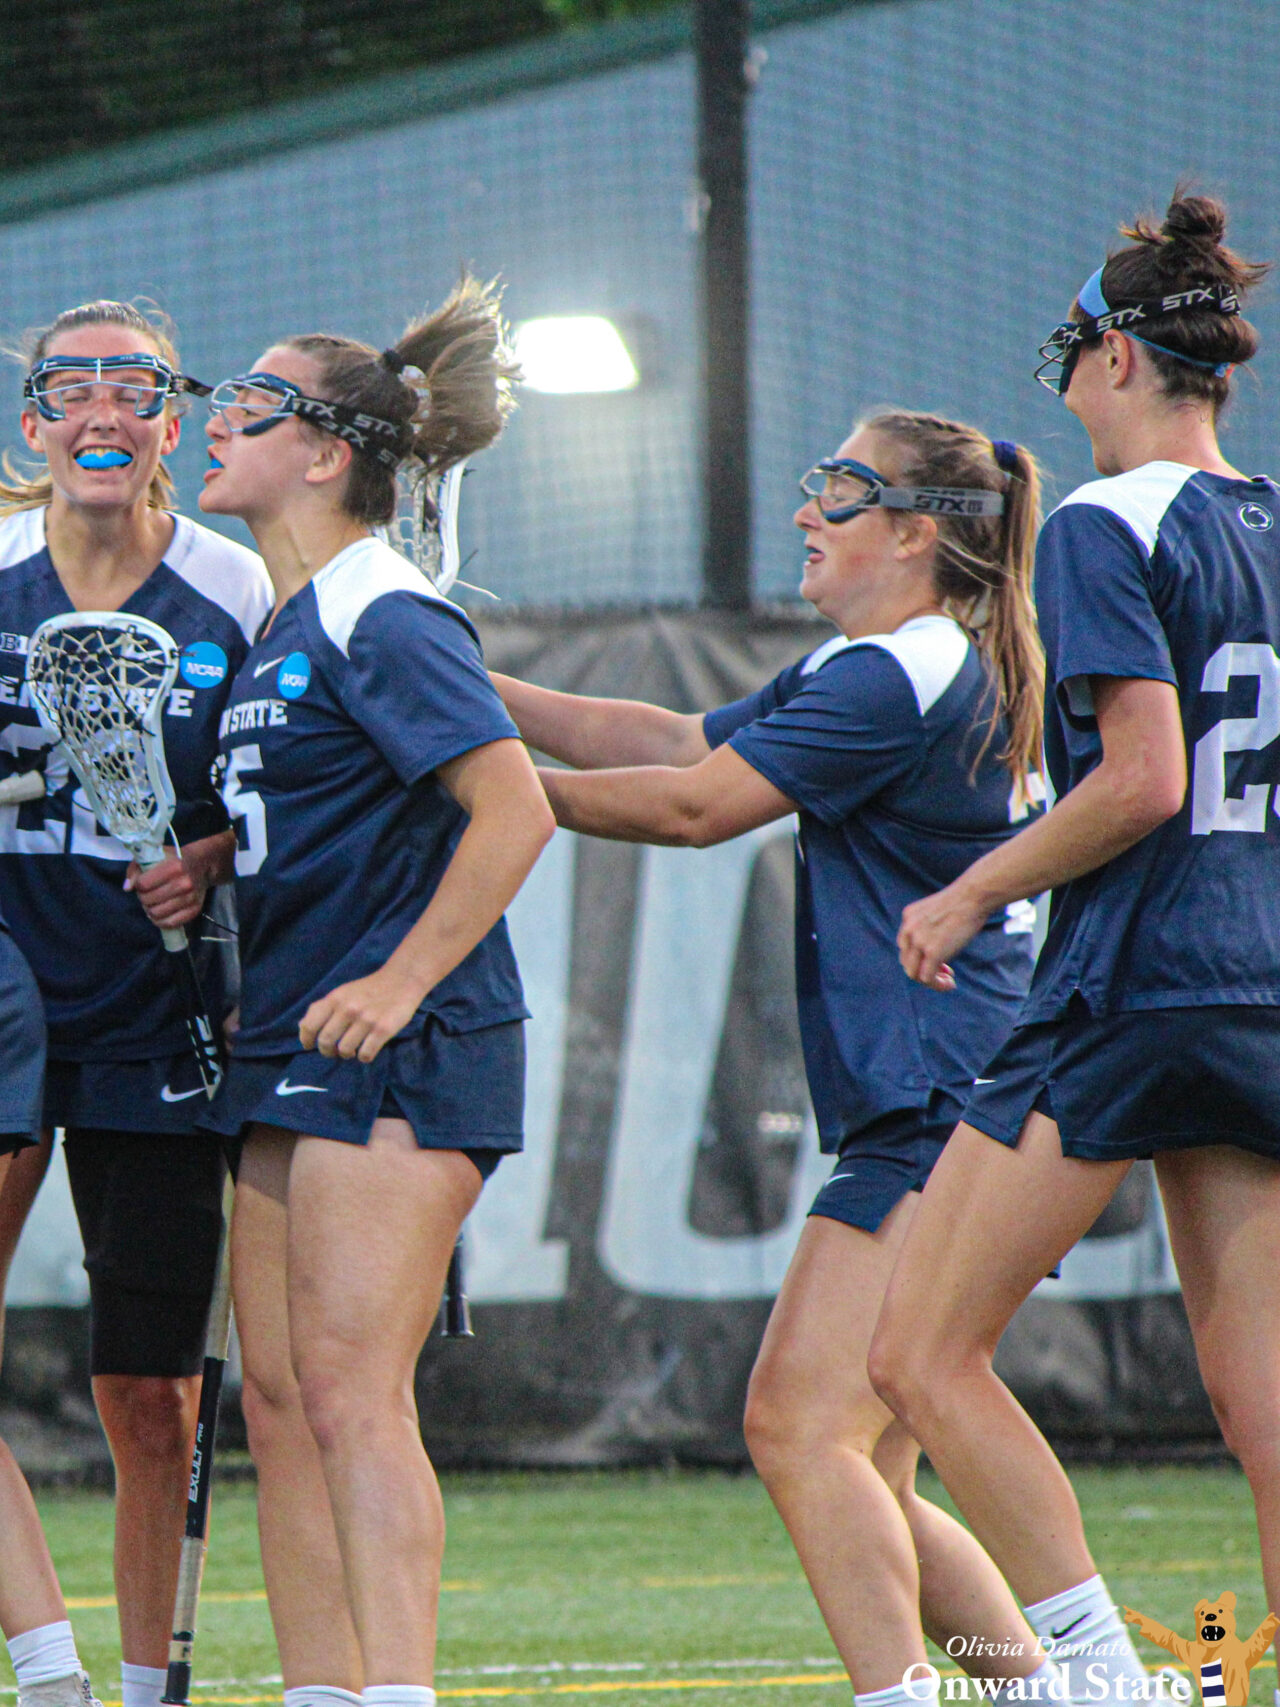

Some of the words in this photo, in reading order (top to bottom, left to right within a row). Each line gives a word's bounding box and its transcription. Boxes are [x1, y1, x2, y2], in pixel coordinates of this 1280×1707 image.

[1162, 287, 1215, 312] STX
[1096, 304, 1147, 334] STX
[353, 412, 400, 438] STX
[913, 494, 966, 513] STX
[185, 662, 225, 679] NCAA
[230, 699, 288, 734] STATE
[1190, 642, 1280, 836] 2
[188, 1444, 203, 1504] EXULT
